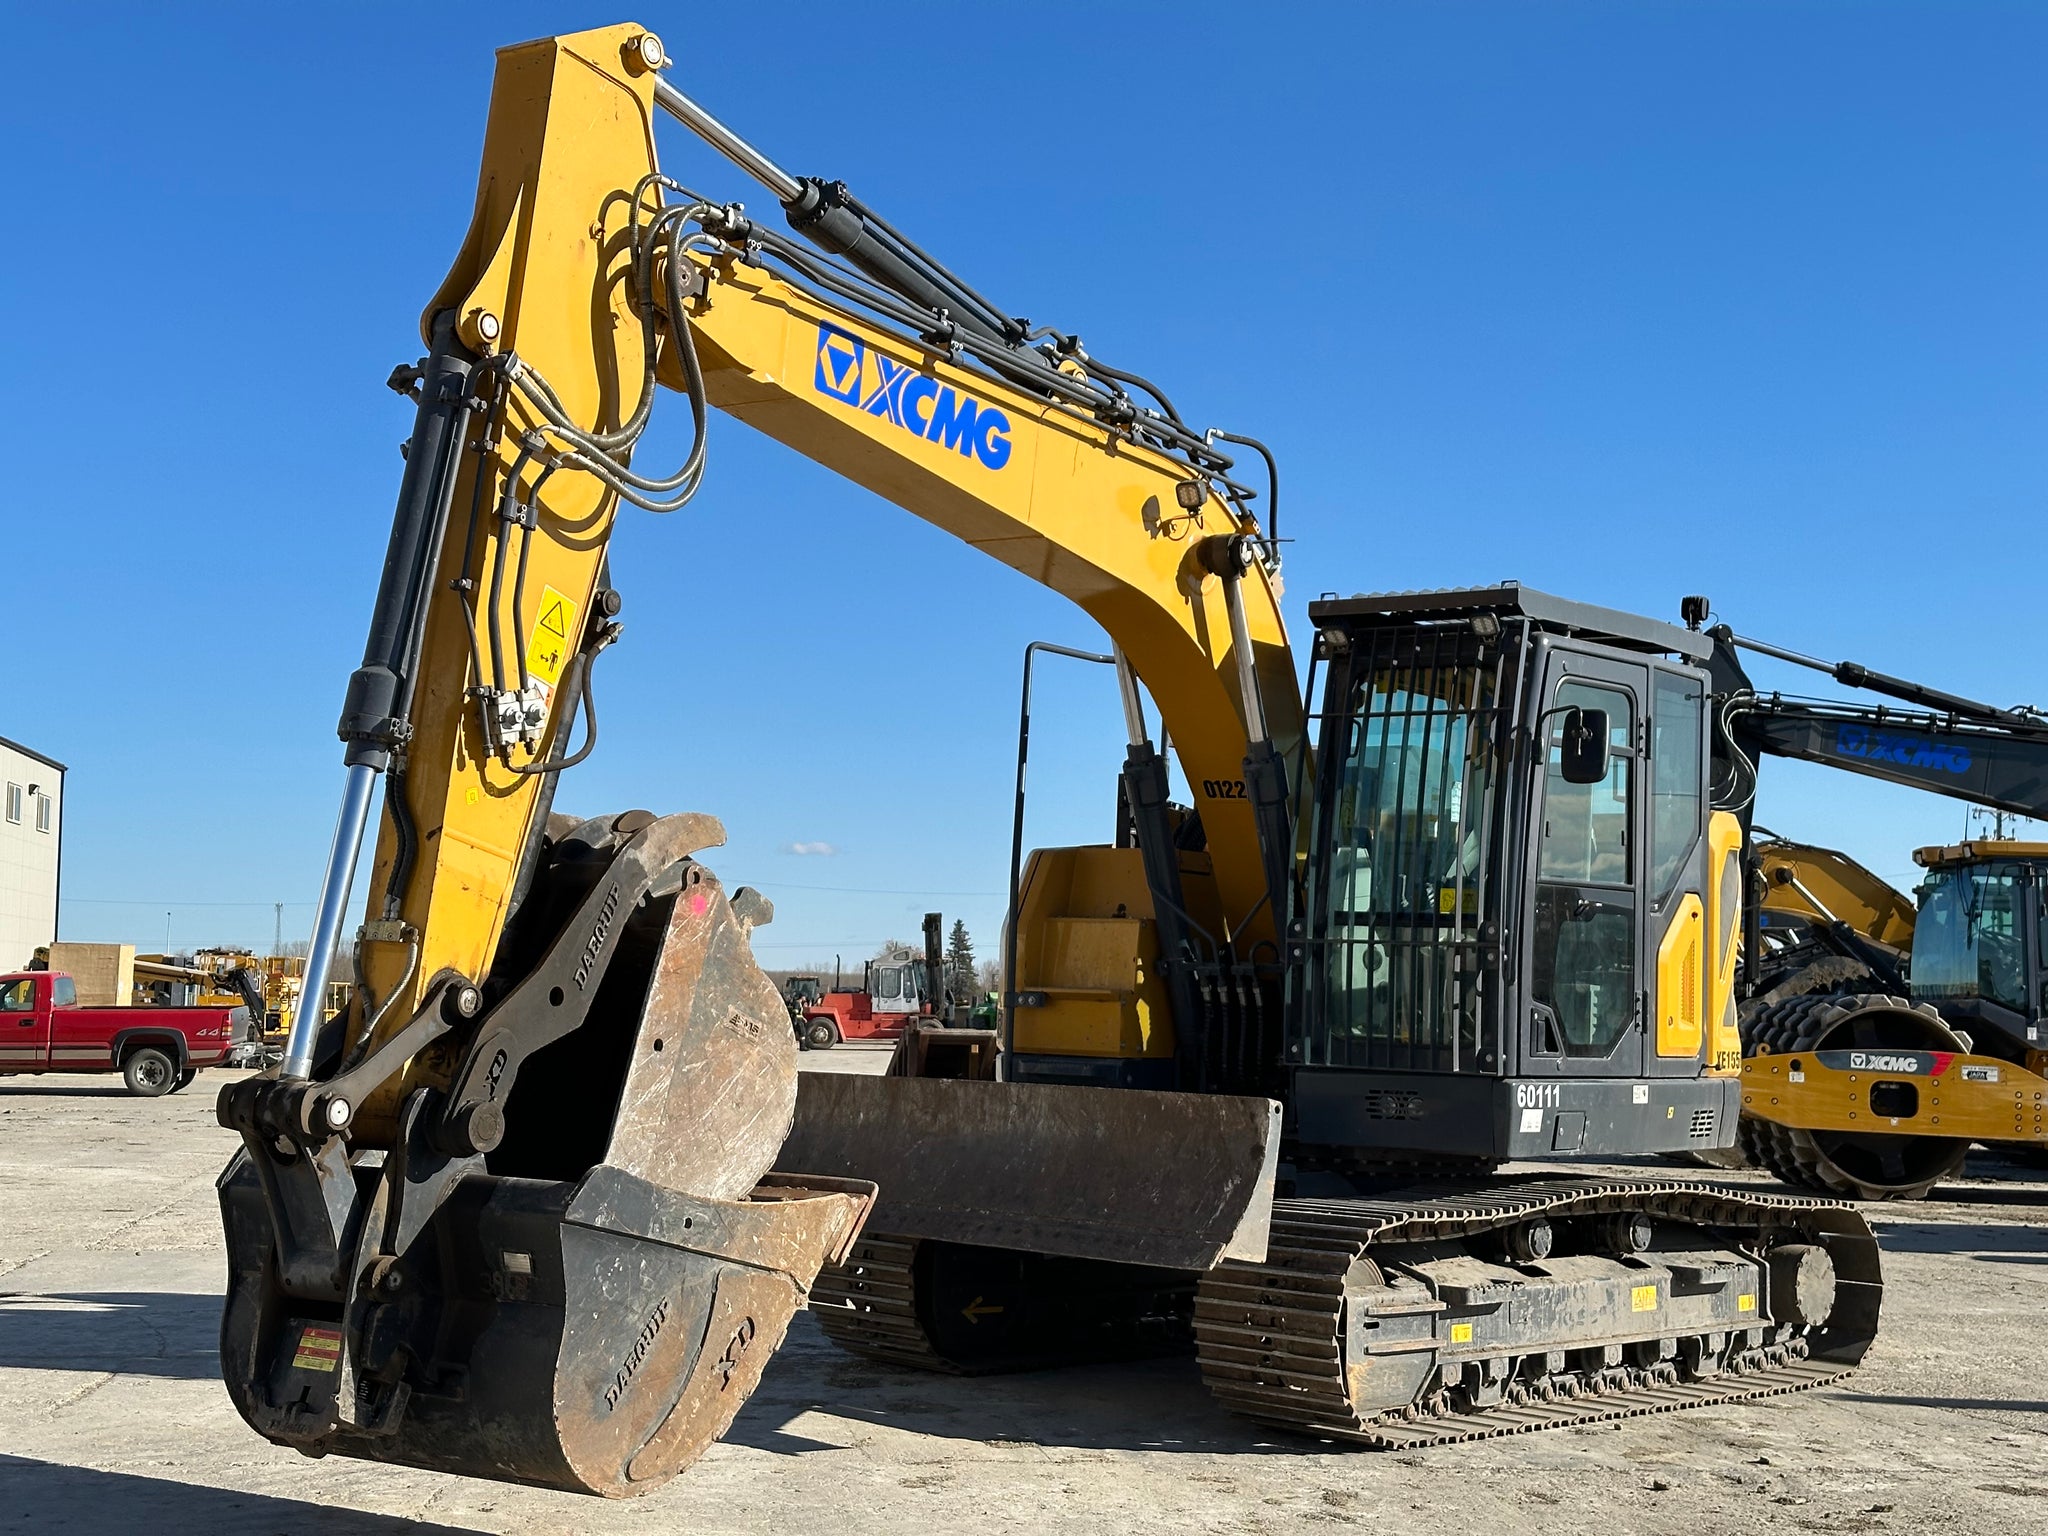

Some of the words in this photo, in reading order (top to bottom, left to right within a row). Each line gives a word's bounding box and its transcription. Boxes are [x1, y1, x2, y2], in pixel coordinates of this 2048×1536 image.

[860, 352, 1012, 470] XCMG
[1868, 734, 1972, 774] XCMG
[1203, 780, 1247, 798] 0122
[573, 881, 620, 991] DAEQUIP
[1865, 1054, 1918, 1073] XCMG
[1517, 1084, 1560, 1108] 60111
